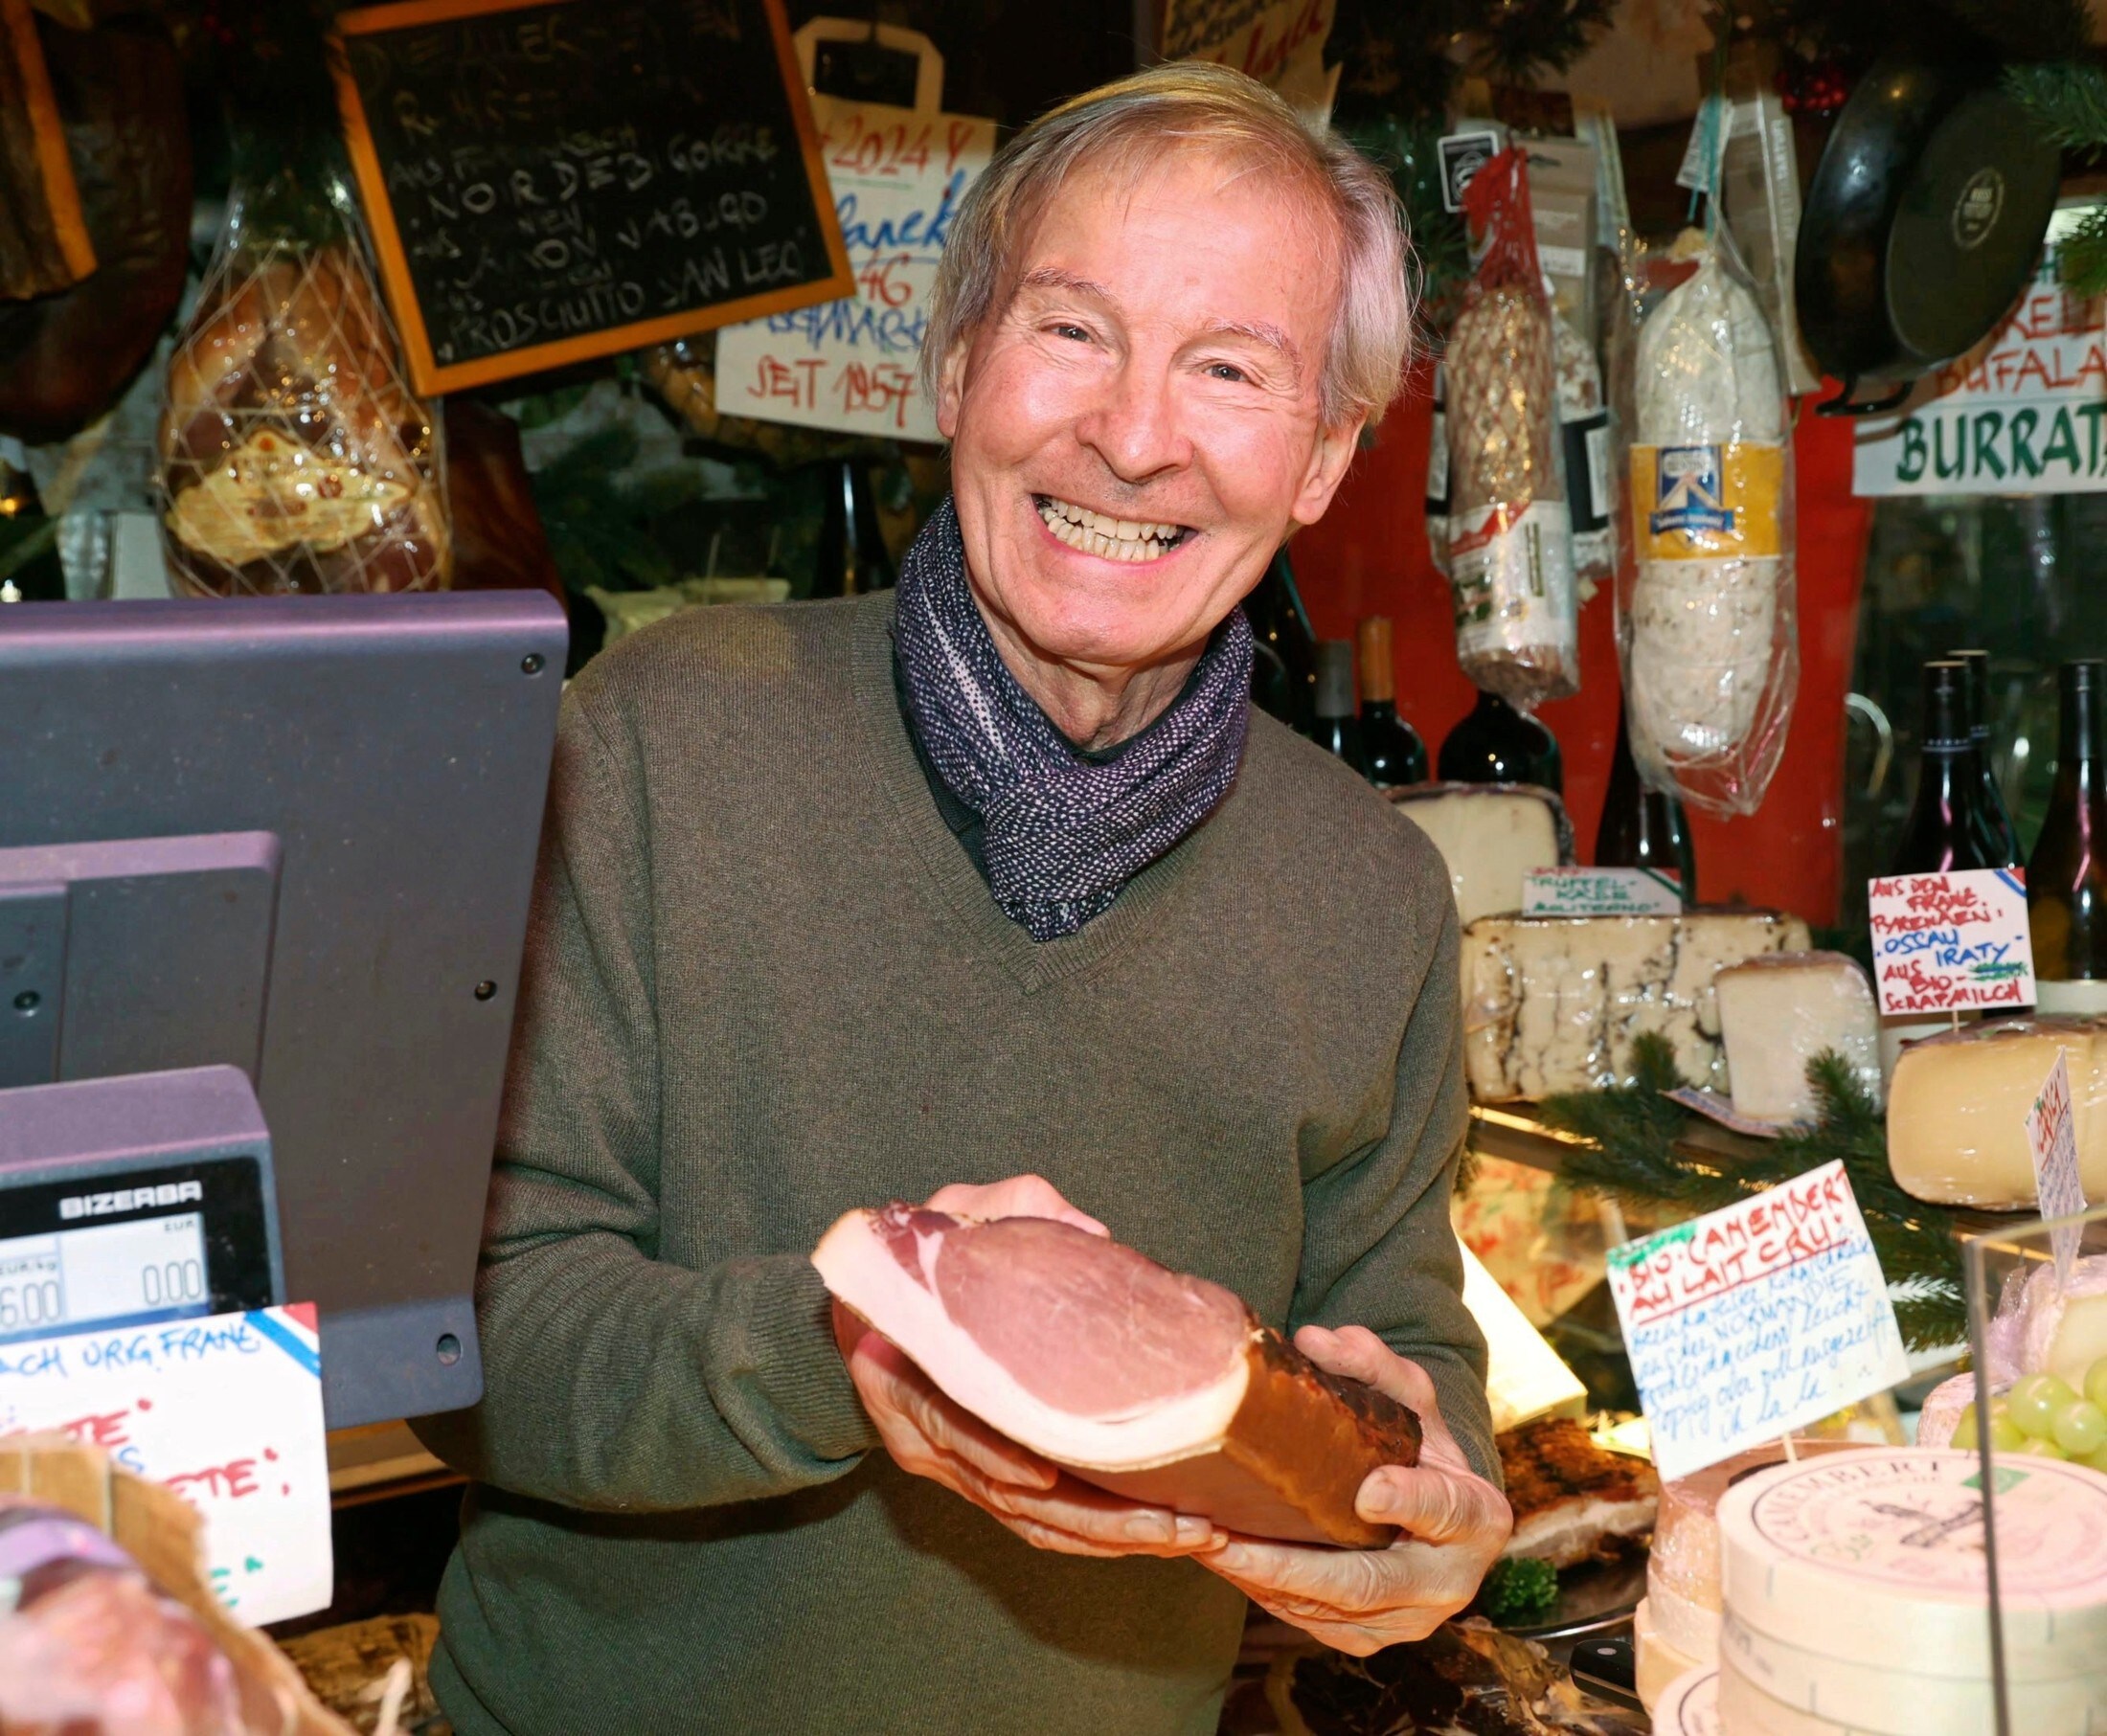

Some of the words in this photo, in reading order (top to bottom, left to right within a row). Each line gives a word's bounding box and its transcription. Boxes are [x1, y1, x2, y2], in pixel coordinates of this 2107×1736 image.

[1896, 401, 2107, 483] BURRAT
[1884, 959, 1921, 982] AUS
[1936, 941, 2009, 967] IRATY
[59, 1180, 202, 1220] BIZERBA
[1683, 1248, 1749, 1296] LAIT
